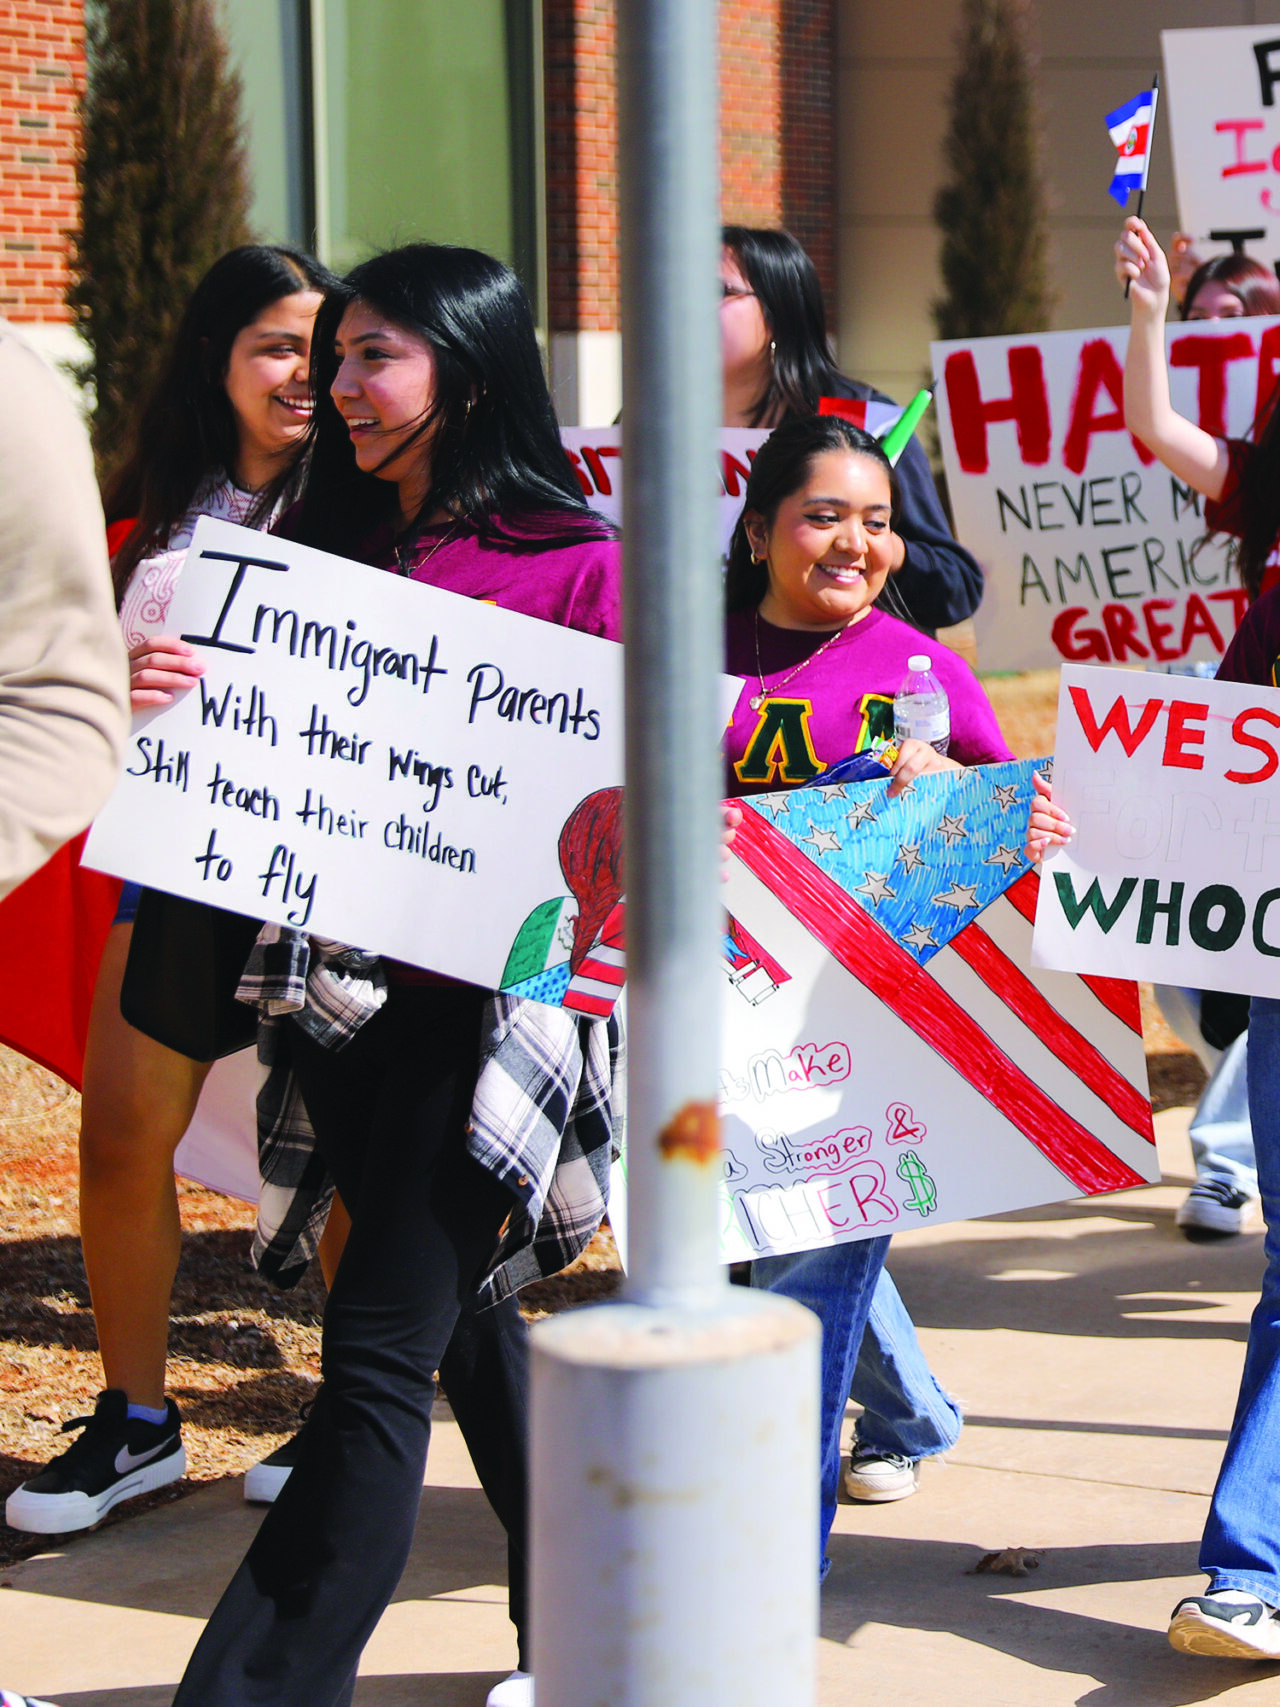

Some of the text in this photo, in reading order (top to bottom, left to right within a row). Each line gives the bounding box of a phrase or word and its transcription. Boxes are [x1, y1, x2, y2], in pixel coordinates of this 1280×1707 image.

[996, 471, 1148, 533] NEVER
[180, 550, 602, 741] Immigrant Parents
[1051, 588, 1249, 663] GREAT
[200, 677, 278, 747] With
[299, 703, 373, 765] their
[1068, 685, 1210, 771] WE
[126, 737, 190, 792] Still
[207, 761, 280, 821] teach
[296, 788, 370, 838] their
[195, 828, 318, 927] to fly
[752, 1052, 844, 1095] Make
[761, 1107, 920, 1168] Stronger &
